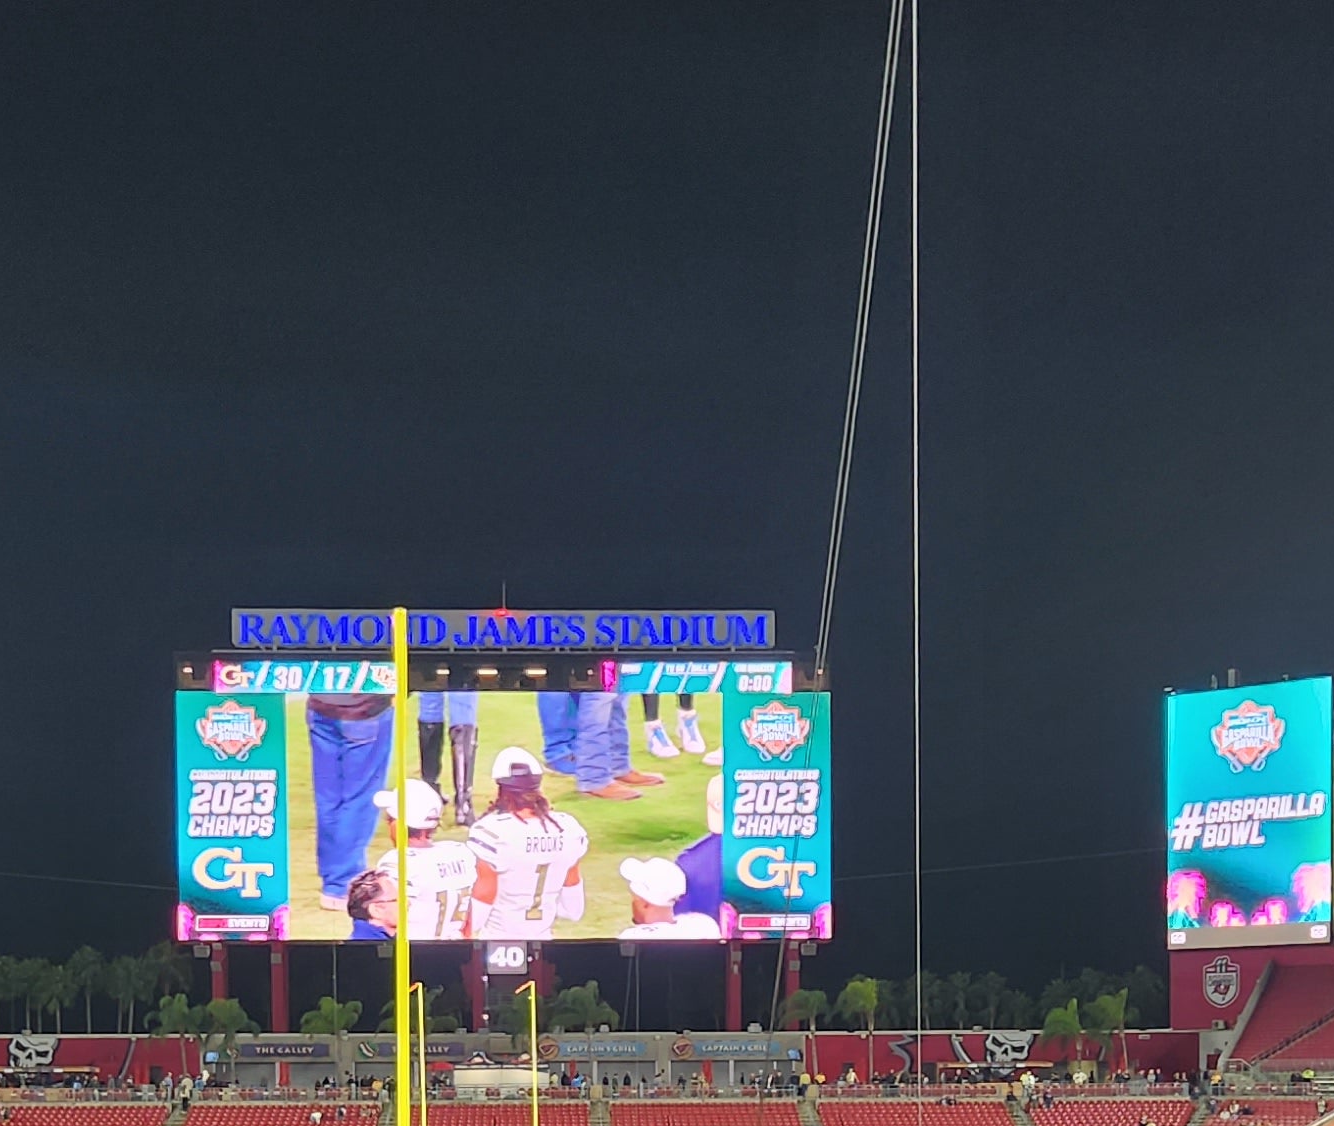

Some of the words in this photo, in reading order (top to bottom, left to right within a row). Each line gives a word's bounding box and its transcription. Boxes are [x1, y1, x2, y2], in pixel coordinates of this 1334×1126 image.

[453, 615, 586, 646] JAMES
[595, 615, 768, 647] STADIUM
[272, 666, 303, 690] 30
[322, 666, 351, 690] 17
[738, 674, 773, 692] 0:00
[189, 782, 277, 814] 2023
[733, 782, 820, 814] 2023
[188, 815, 275, 838] CHAMPS
[732, 815, 818, 838] CHAMPS
[1202, 820, 1266, 850] BOWL
[525, 836, 564, 853] BROOKS
[192, 846, 275, 898] GT
[736, 845, 817, 899] GT
[524, 863, 550, 921] 1
[488, 946, 525, 968] 40
[277, 1046, 315, 1055] GALLEY
[413, 1046, 450, 1054] GLLEY
